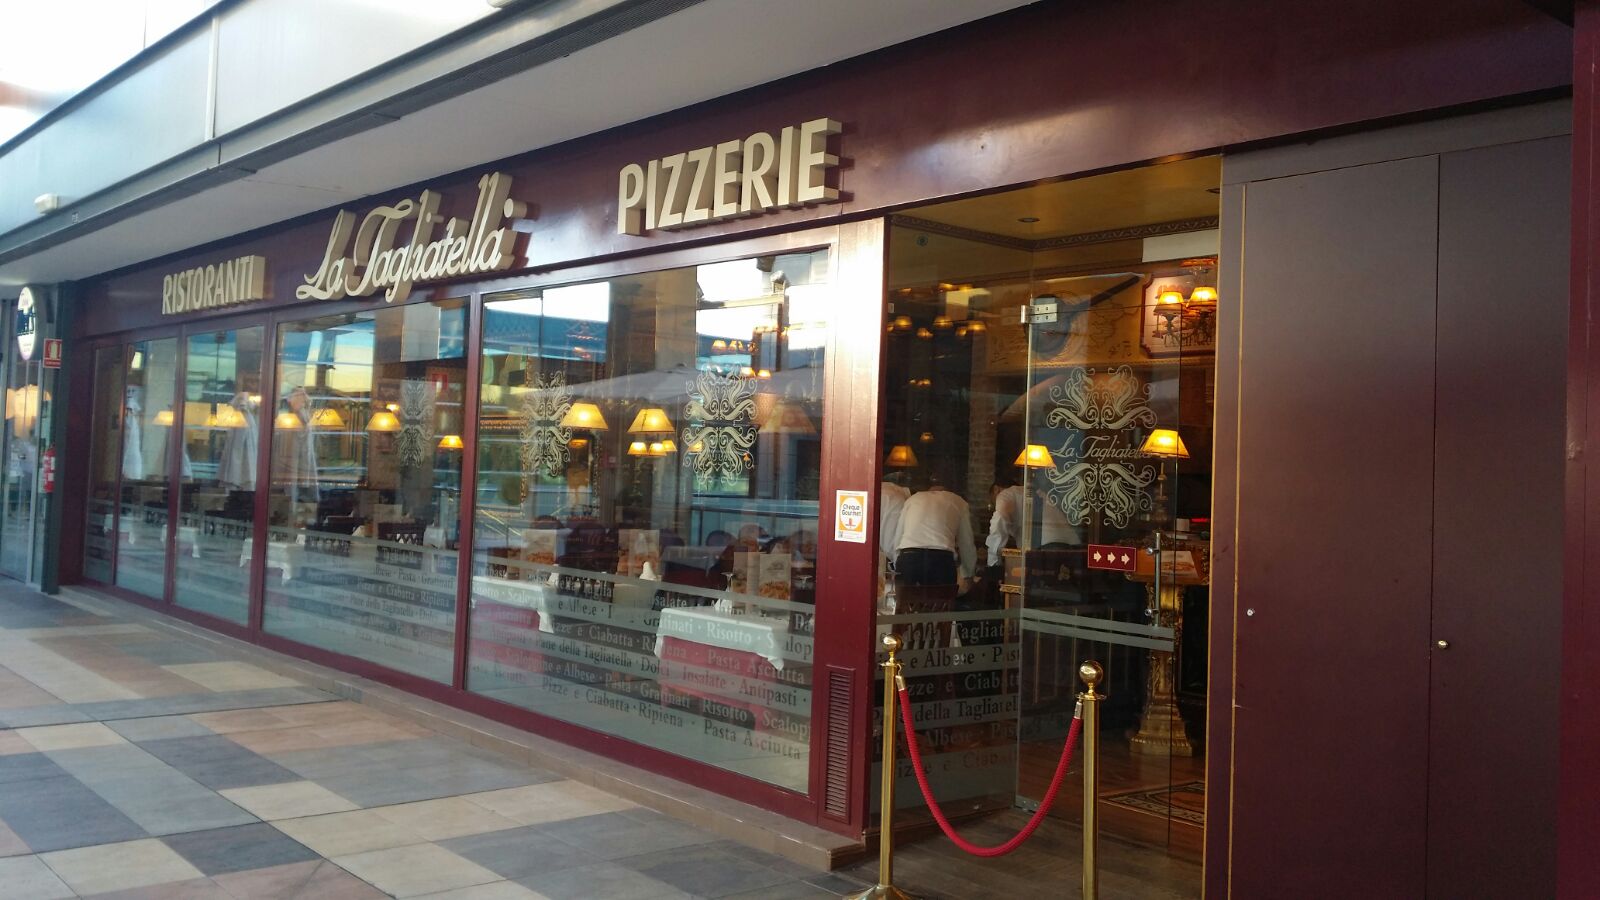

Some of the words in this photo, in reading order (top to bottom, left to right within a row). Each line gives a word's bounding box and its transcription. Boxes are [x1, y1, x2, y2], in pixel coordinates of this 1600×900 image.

[617, 117, 843, 236] PIZZERIE
[296, 208, 354, 300] La
[345, 171, 528, 304] Tagliatella
[161, 254, 266, 316] RISTORANTI
[1049, 433, 1075, 458] La
[588, 624, 634, 649] Ciabatta
[708, 647, 742, 673] Pasta
[706, 620, 752, 645] Risotto
[559, 637, 582, 658] della
[583, 643, 633, 671] Tagliatella
[641, 655, 670, 679] Dolci
[738, 679, 798, 709] Antipasti
[910, 656, 919, 669] e
[945, 680, 953, 693] e
[564, 660, 597, 684] Albese
[702, 699, 749, 724] Risotto
[585, 687, 631, 715] Ciabatta
[638, 700, 684, 729] Ripiena
[703, 718, 738, 744] Pasta
[914, 702, 951, 724] della
